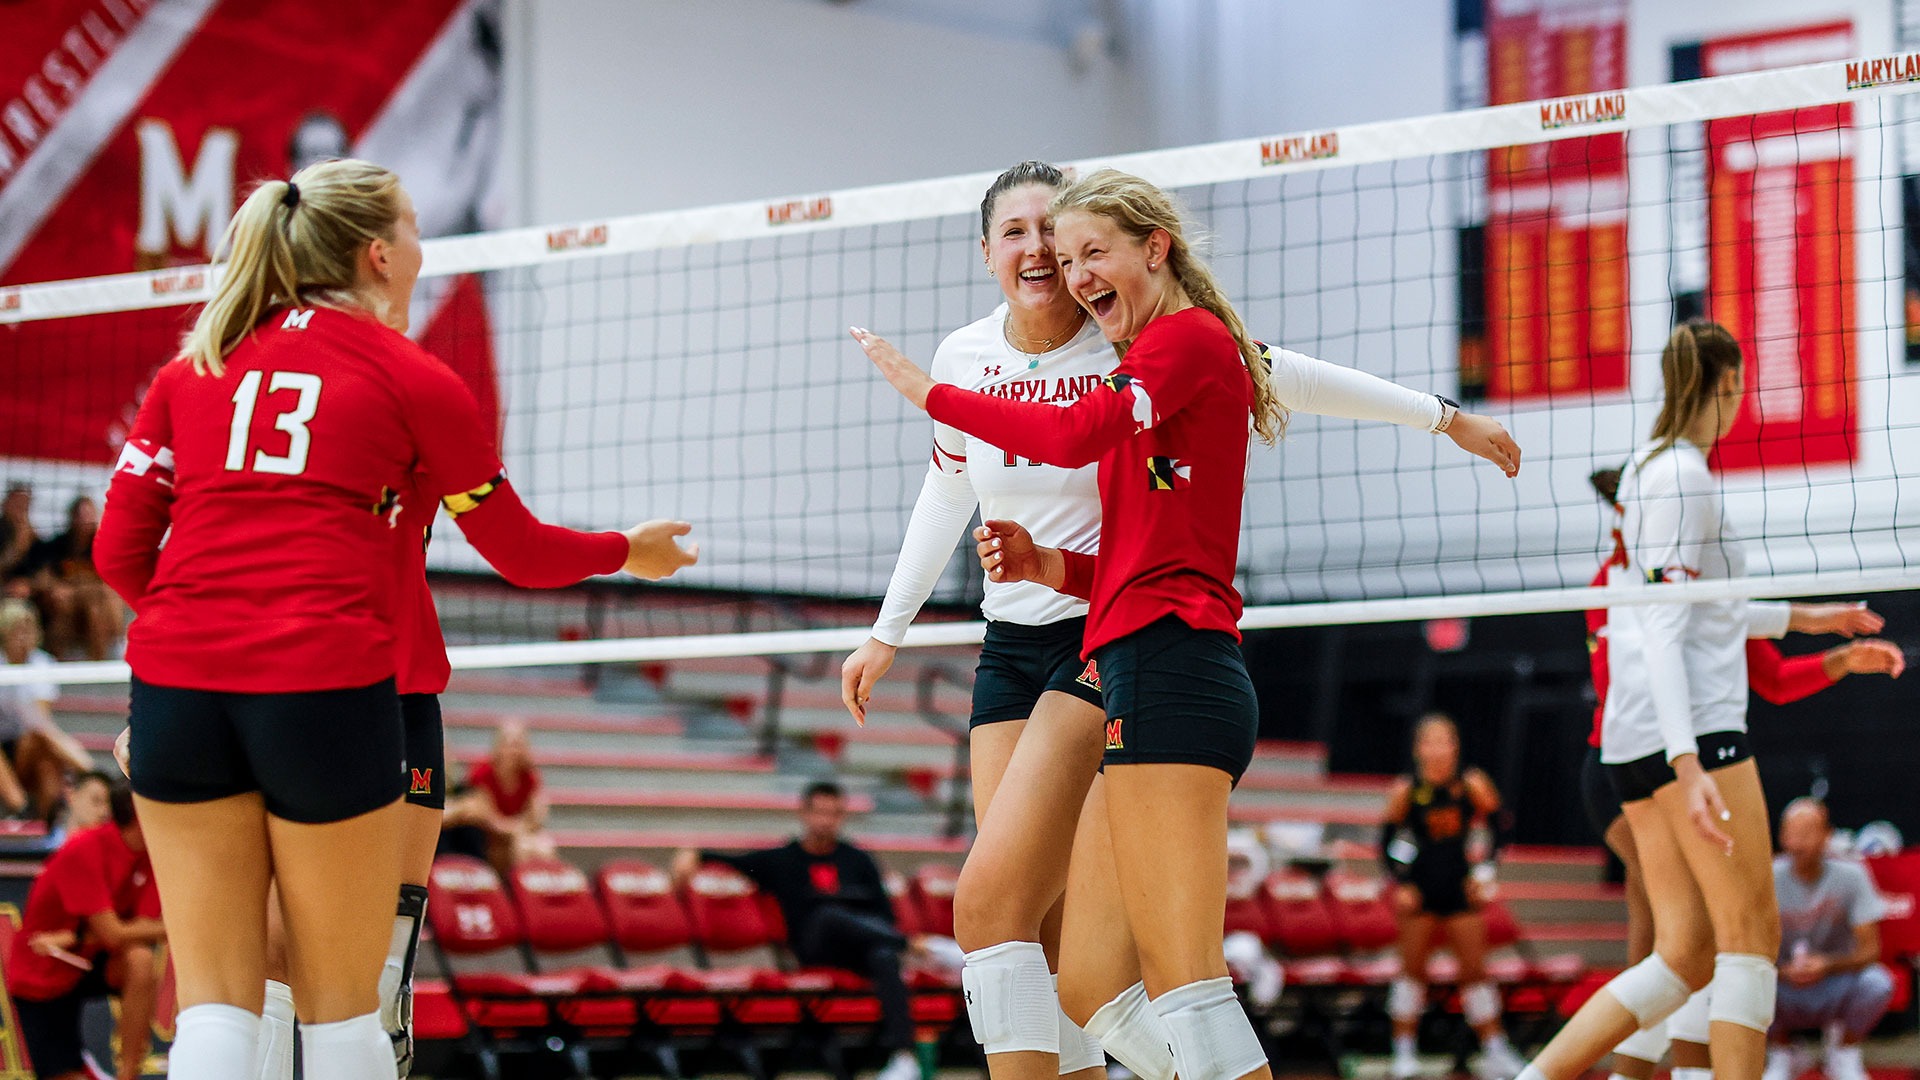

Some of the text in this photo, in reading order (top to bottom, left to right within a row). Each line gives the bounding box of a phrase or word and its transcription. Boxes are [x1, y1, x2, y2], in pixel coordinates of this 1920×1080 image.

[1540, 94, 1626, 126] MARYLAND
[136, 118, 241, 262] M
[281, 309, 315, 329] M
[224, 370, 322, 475] 13
[1106, 718, 1122, 747] M
[410, 767, 432, 792] M
